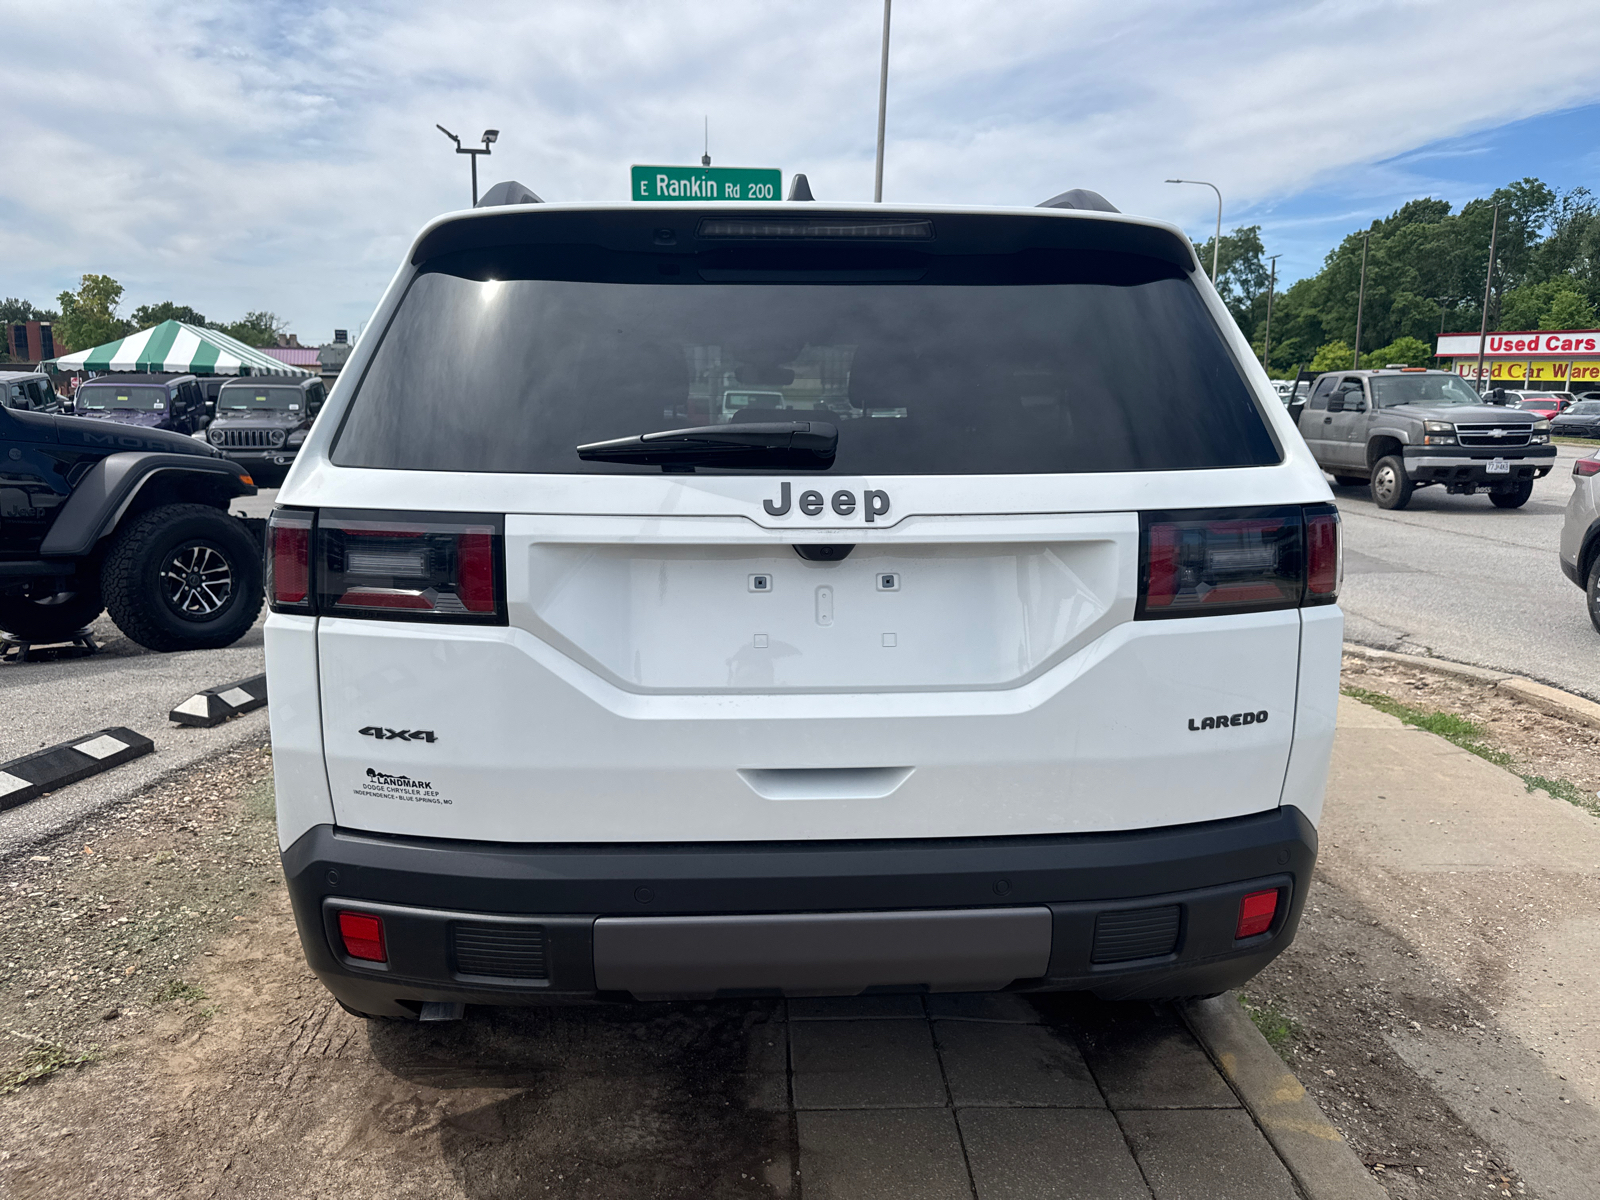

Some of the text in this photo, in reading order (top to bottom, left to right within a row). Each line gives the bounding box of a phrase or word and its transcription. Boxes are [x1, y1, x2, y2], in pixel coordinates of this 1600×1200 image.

[640, 174, 773, 199] E Rankin Rd 200
[1489, 335, 1596, 352] Used Cars
[763, 481, 891, 522] Jeep
[7, 504, 46, 519] Jeep
[1188, 710, 1269, 731] LAREDO
[362, 783, 385, 792] DODGE
[386, 786, 421, 796] CHRYSLER
[377, 776, 432, 789] LANDMARK
[353, 789, 395, 800] INDEPENDENCE
